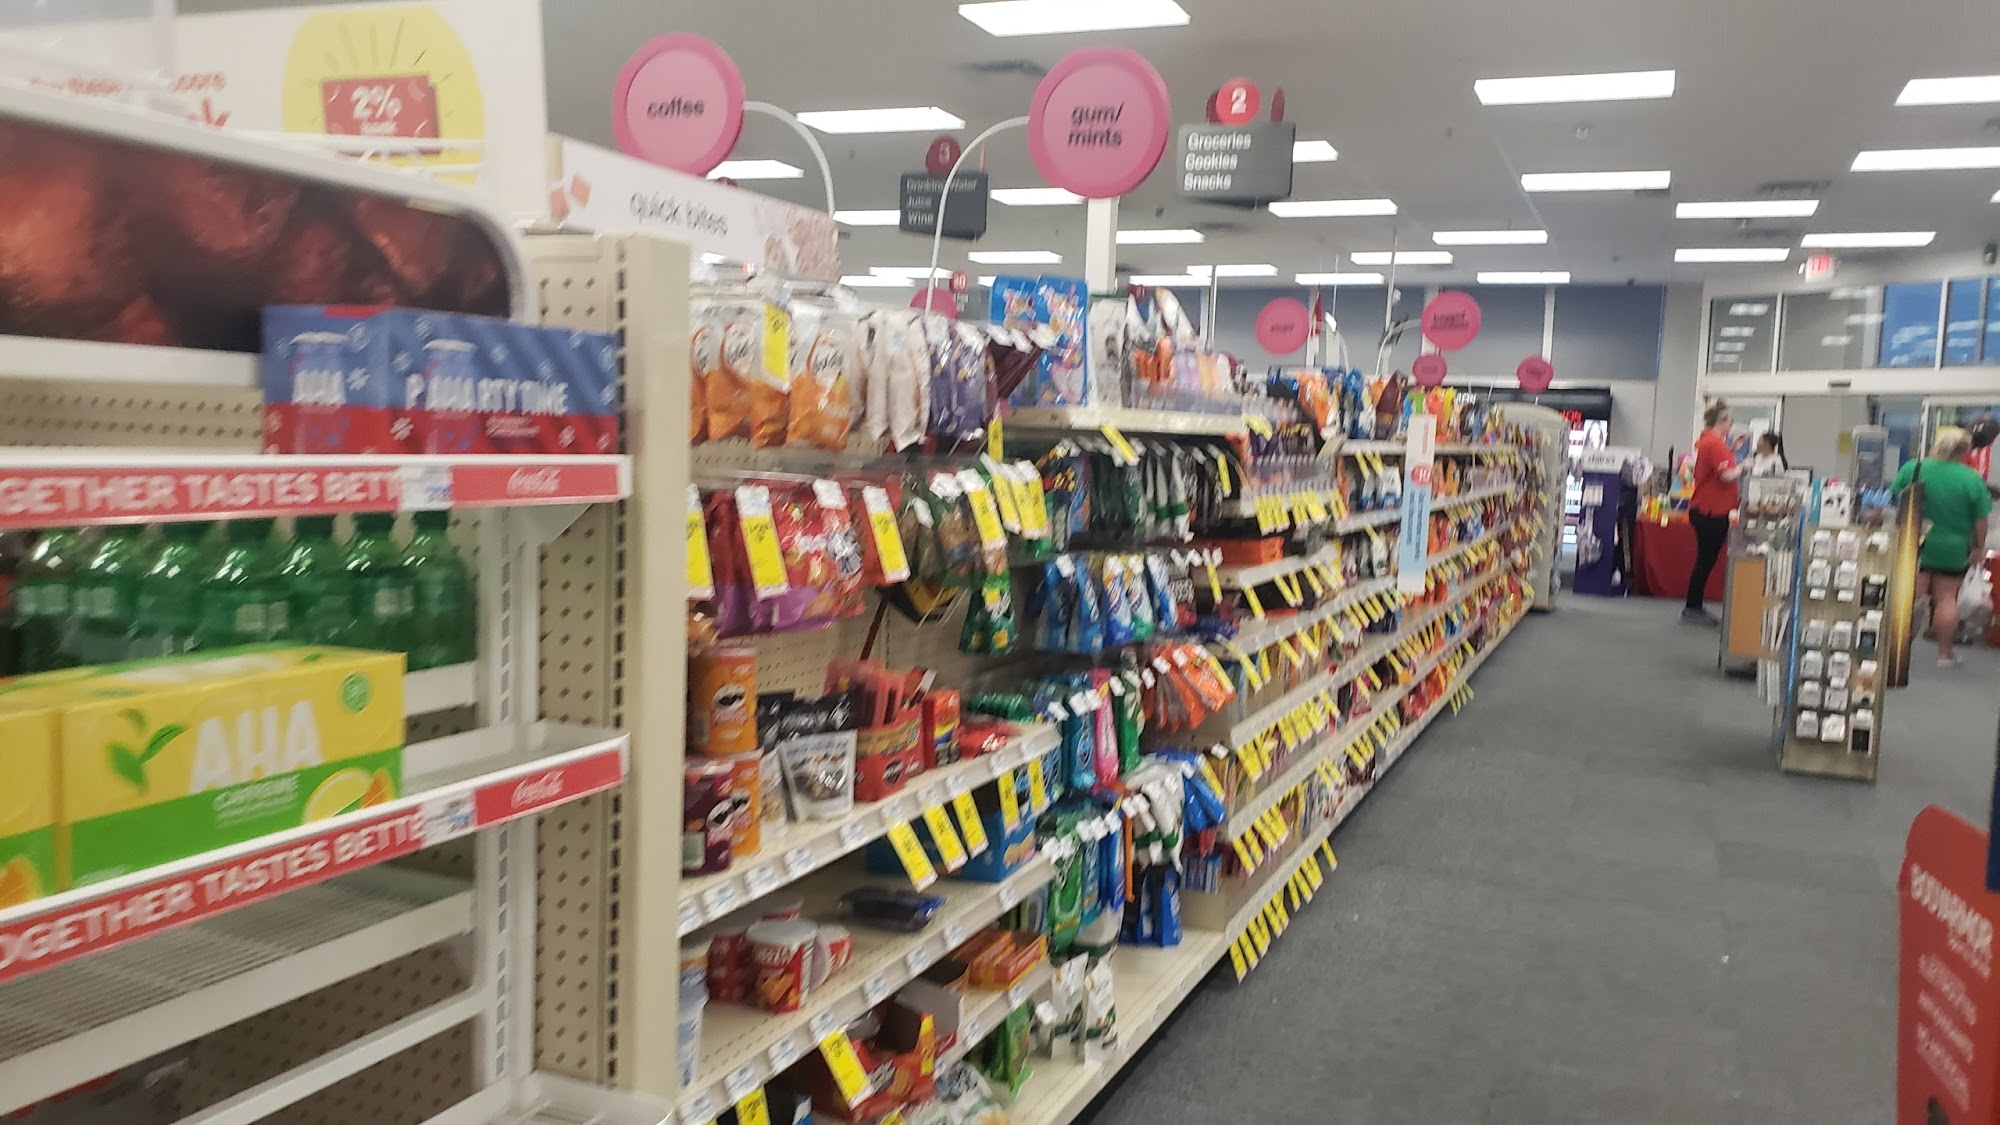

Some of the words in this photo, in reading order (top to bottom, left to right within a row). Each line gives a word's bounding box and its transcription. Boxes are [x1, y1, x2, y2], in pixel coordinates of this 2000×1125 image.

[350, 84, 402, 120] 2%
[647, 96, 705, 118] coffee
[1230, 86, 1248, 114] 2
[1071, 102, 1125, 124] gum/
[1068, 128, 1123, 148] mints
[1187, 132, 1252, 151] Groceries
[1185, 152, 1239, 171] Cookies
[1183, 172, 1233, 191] Snacks
[906, 194, 933, 209] Juice
[629, 191, 682, 225] quick
[685, 199, 729, 238] bites
[907, 211, 935, 226] Wine
[0, 474, 180, 515] GETHER
[180, 471, 320, 508] TASTES
[189, 699, 325, 796] AHA
[199, 838, 331, 905] TASTES
